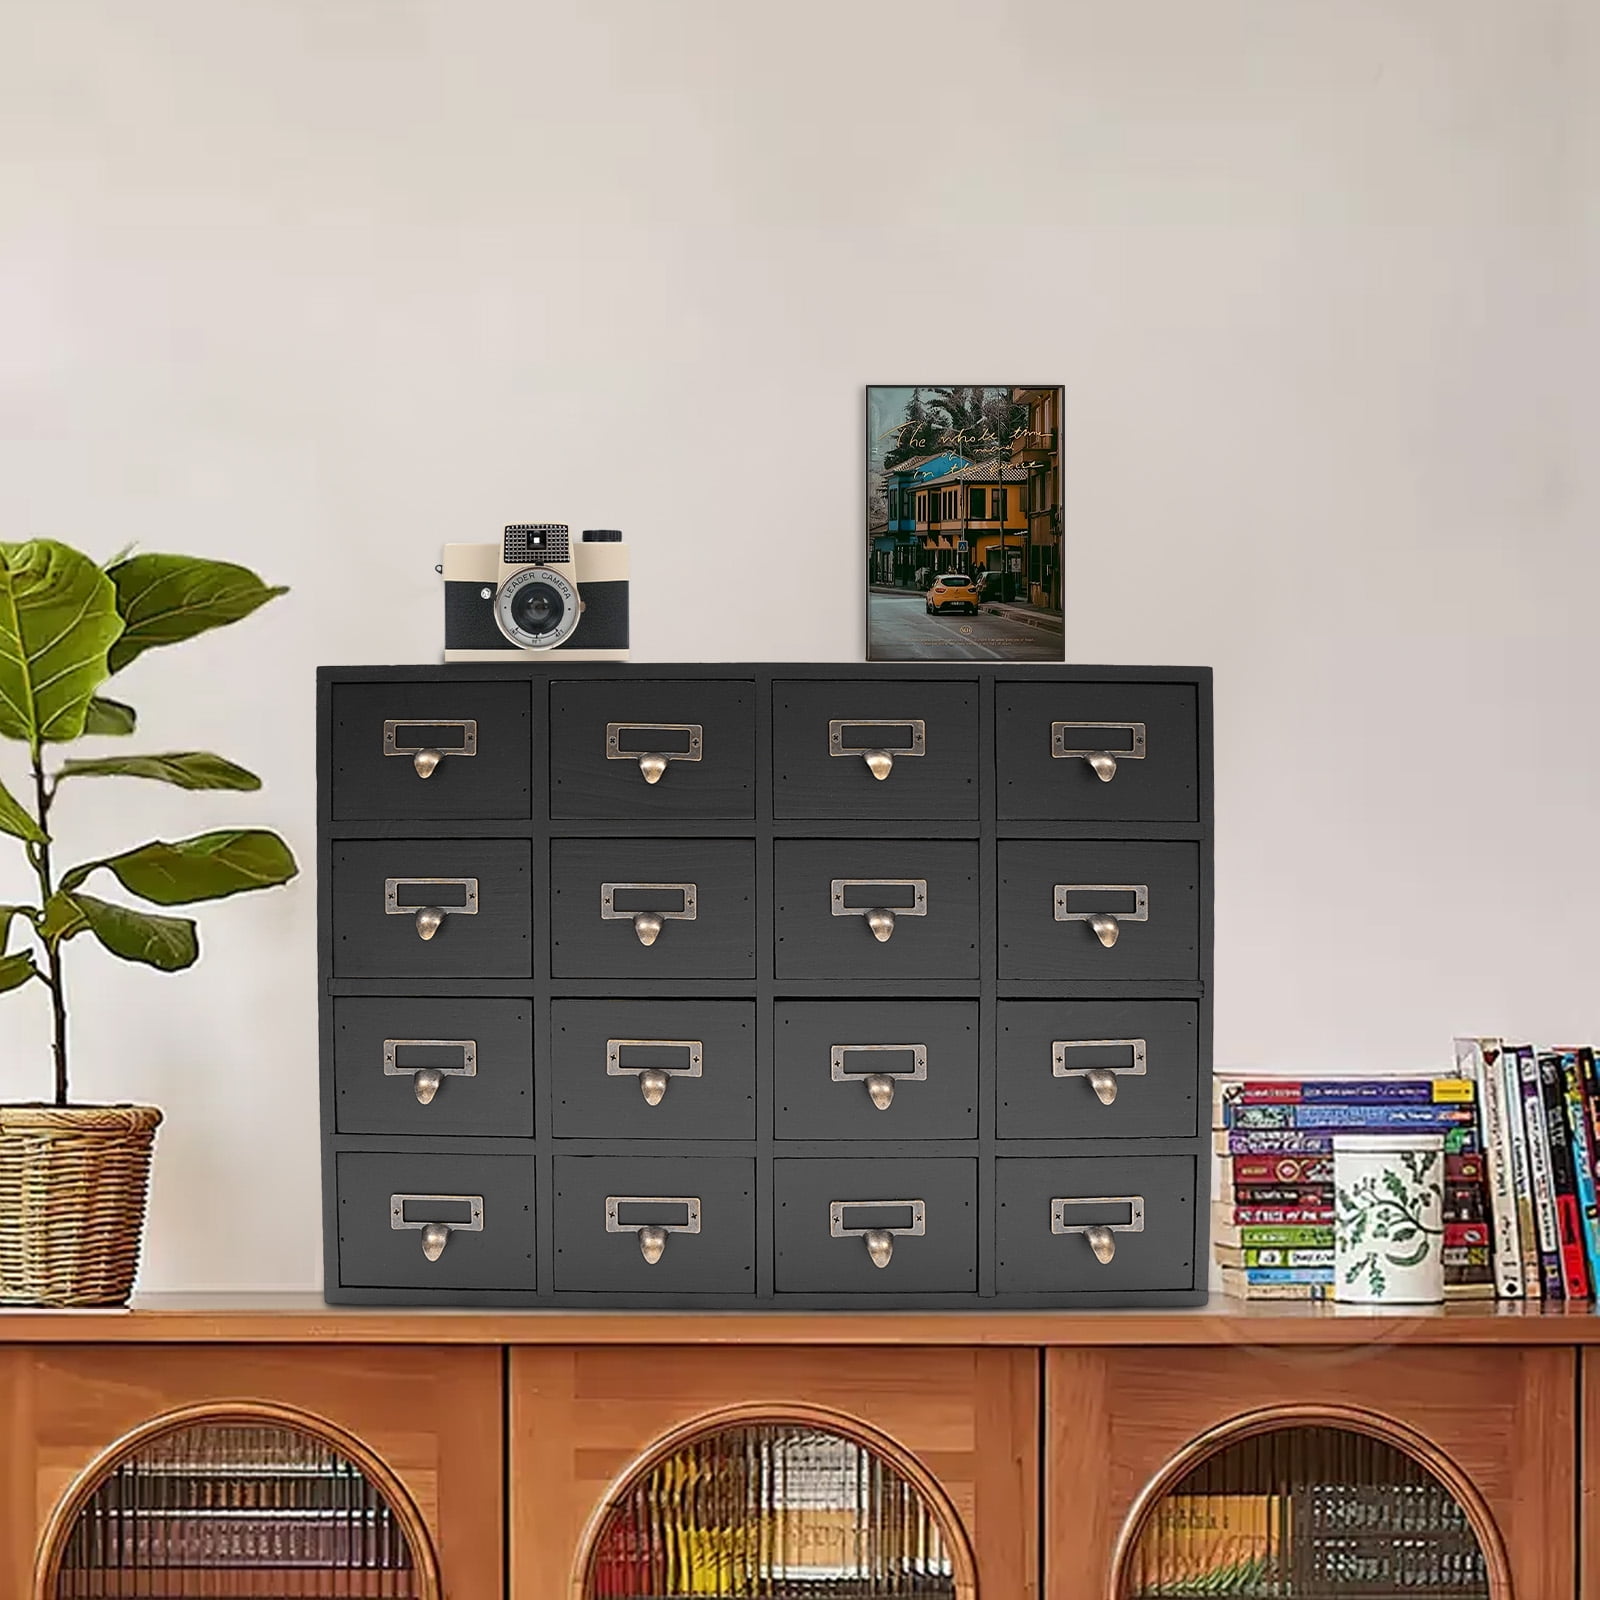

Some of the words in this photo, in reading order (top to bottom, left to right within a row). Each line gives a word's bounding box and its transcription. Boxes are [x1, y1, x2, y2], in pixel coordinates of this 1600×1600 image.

[879, 420, 926, 448] The
[940, 428, 998, 444] whole
[504, 572, 536, 599] LEADER
[541, 572, 571, 600] CAMERA
